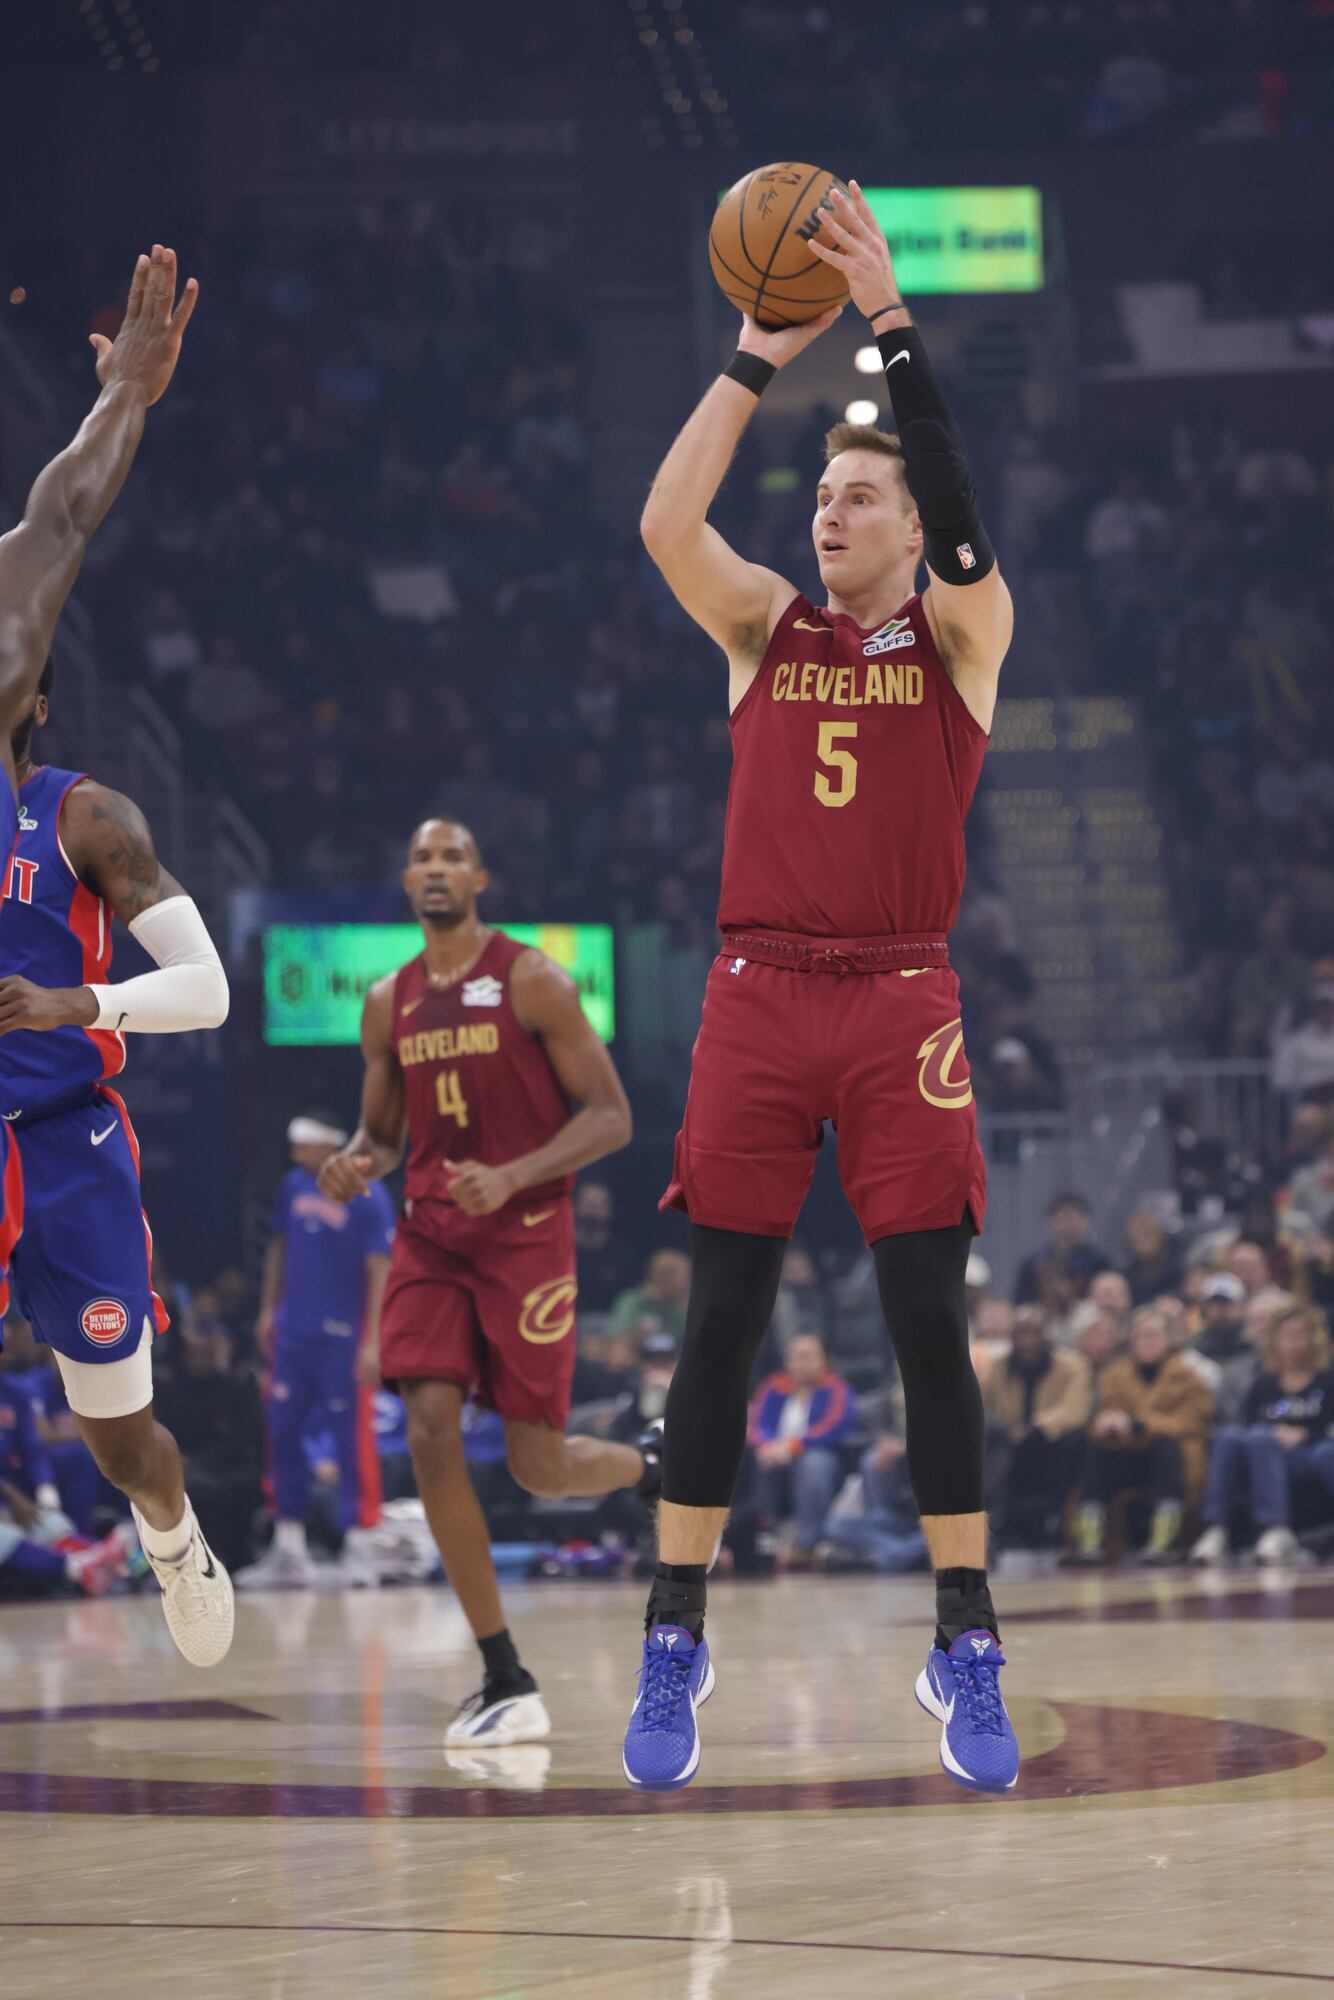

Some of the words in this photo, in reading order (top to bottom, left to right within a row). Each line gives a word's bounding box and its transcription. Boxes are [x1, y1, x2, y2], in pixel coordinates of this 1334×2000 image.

[865, 633, 914, 654] CLIFFS
[772, 662, 924, 706] CLEVELAND
[814, 721, 858, 807] 5
[399, 1023, 499, 1066] CLEVELAND
[436, 1069, 469, 1128] 4
[89, 1313, 120, 1323] DETROIT
[89, 1320, 121, 1331] PISTONS
